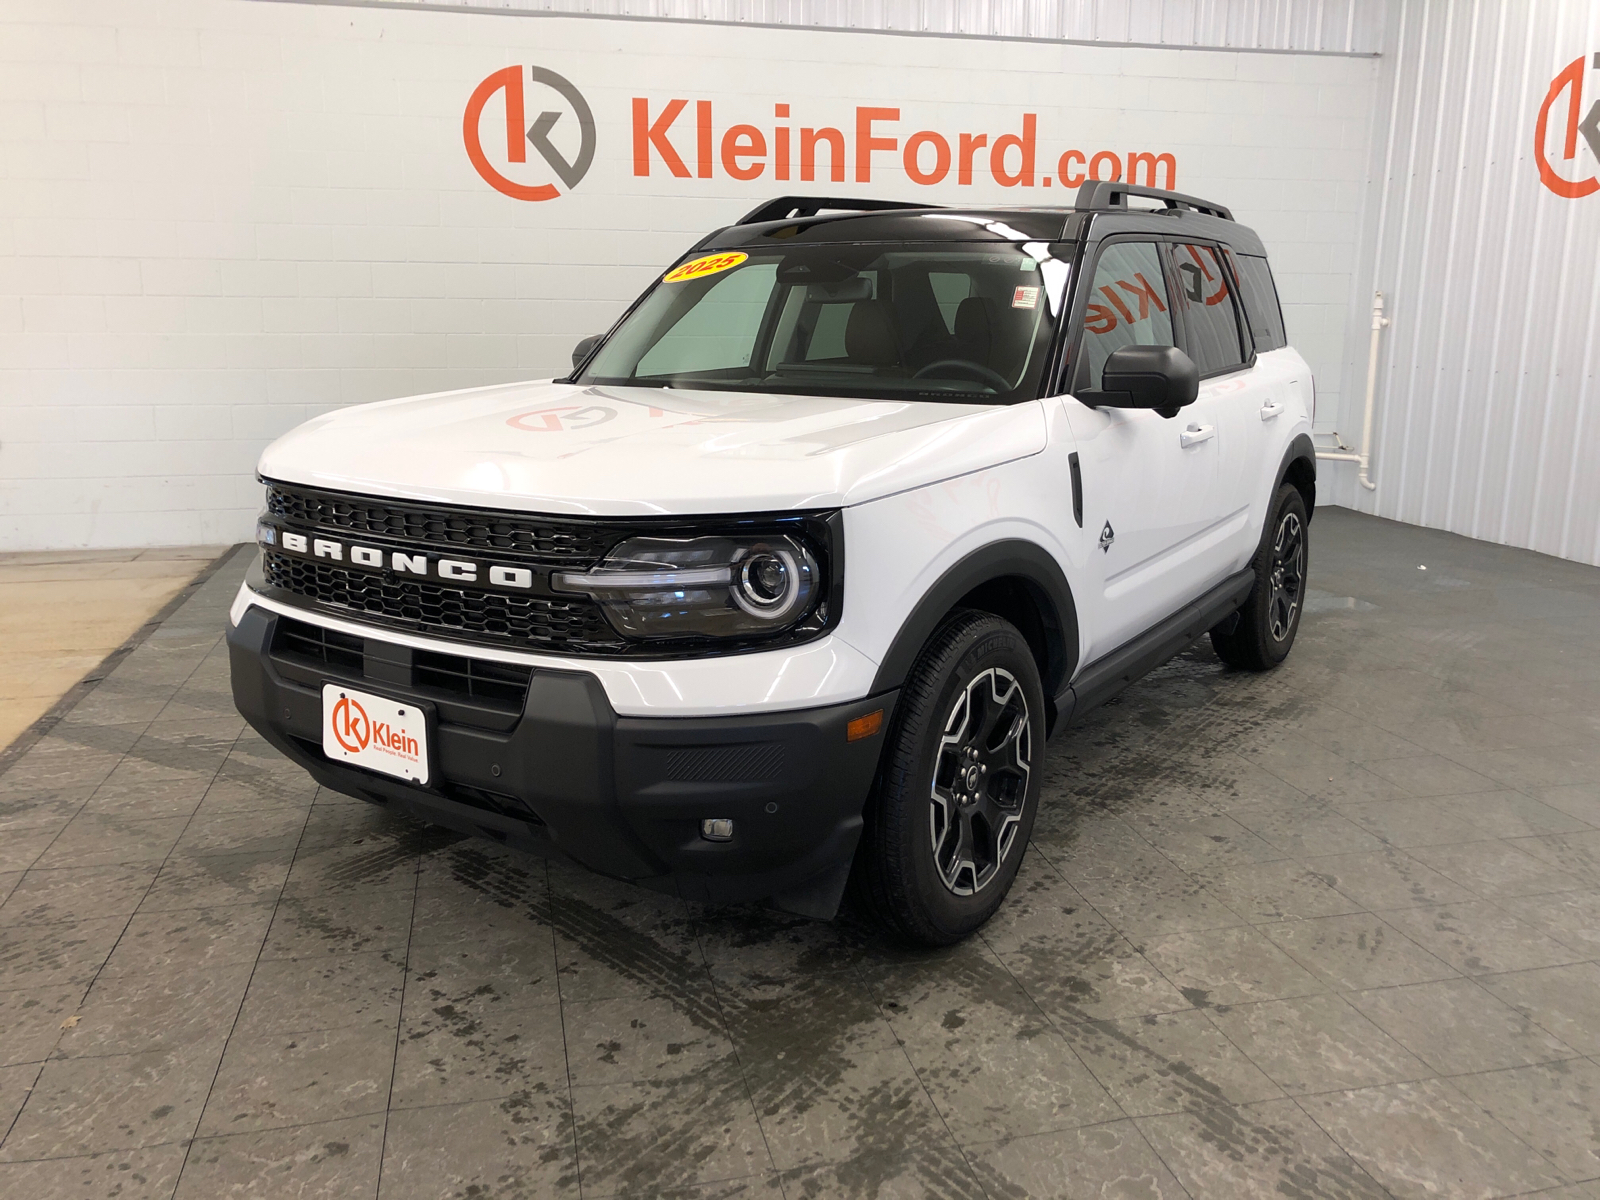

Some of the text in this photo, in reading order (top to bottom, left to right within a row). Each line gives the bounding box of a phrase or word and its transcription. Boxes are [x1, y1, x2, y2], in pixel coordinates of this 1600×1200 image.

[632, 97, 1177, 191] KleinFord.com
[668, 254, 742, 281] 2025
[282, 531, 533, 589] BRONCO
[372, 720, 419, 757] Klein
[373, 744, 382, 752] Real
[397, 751, 407, 759] Real
